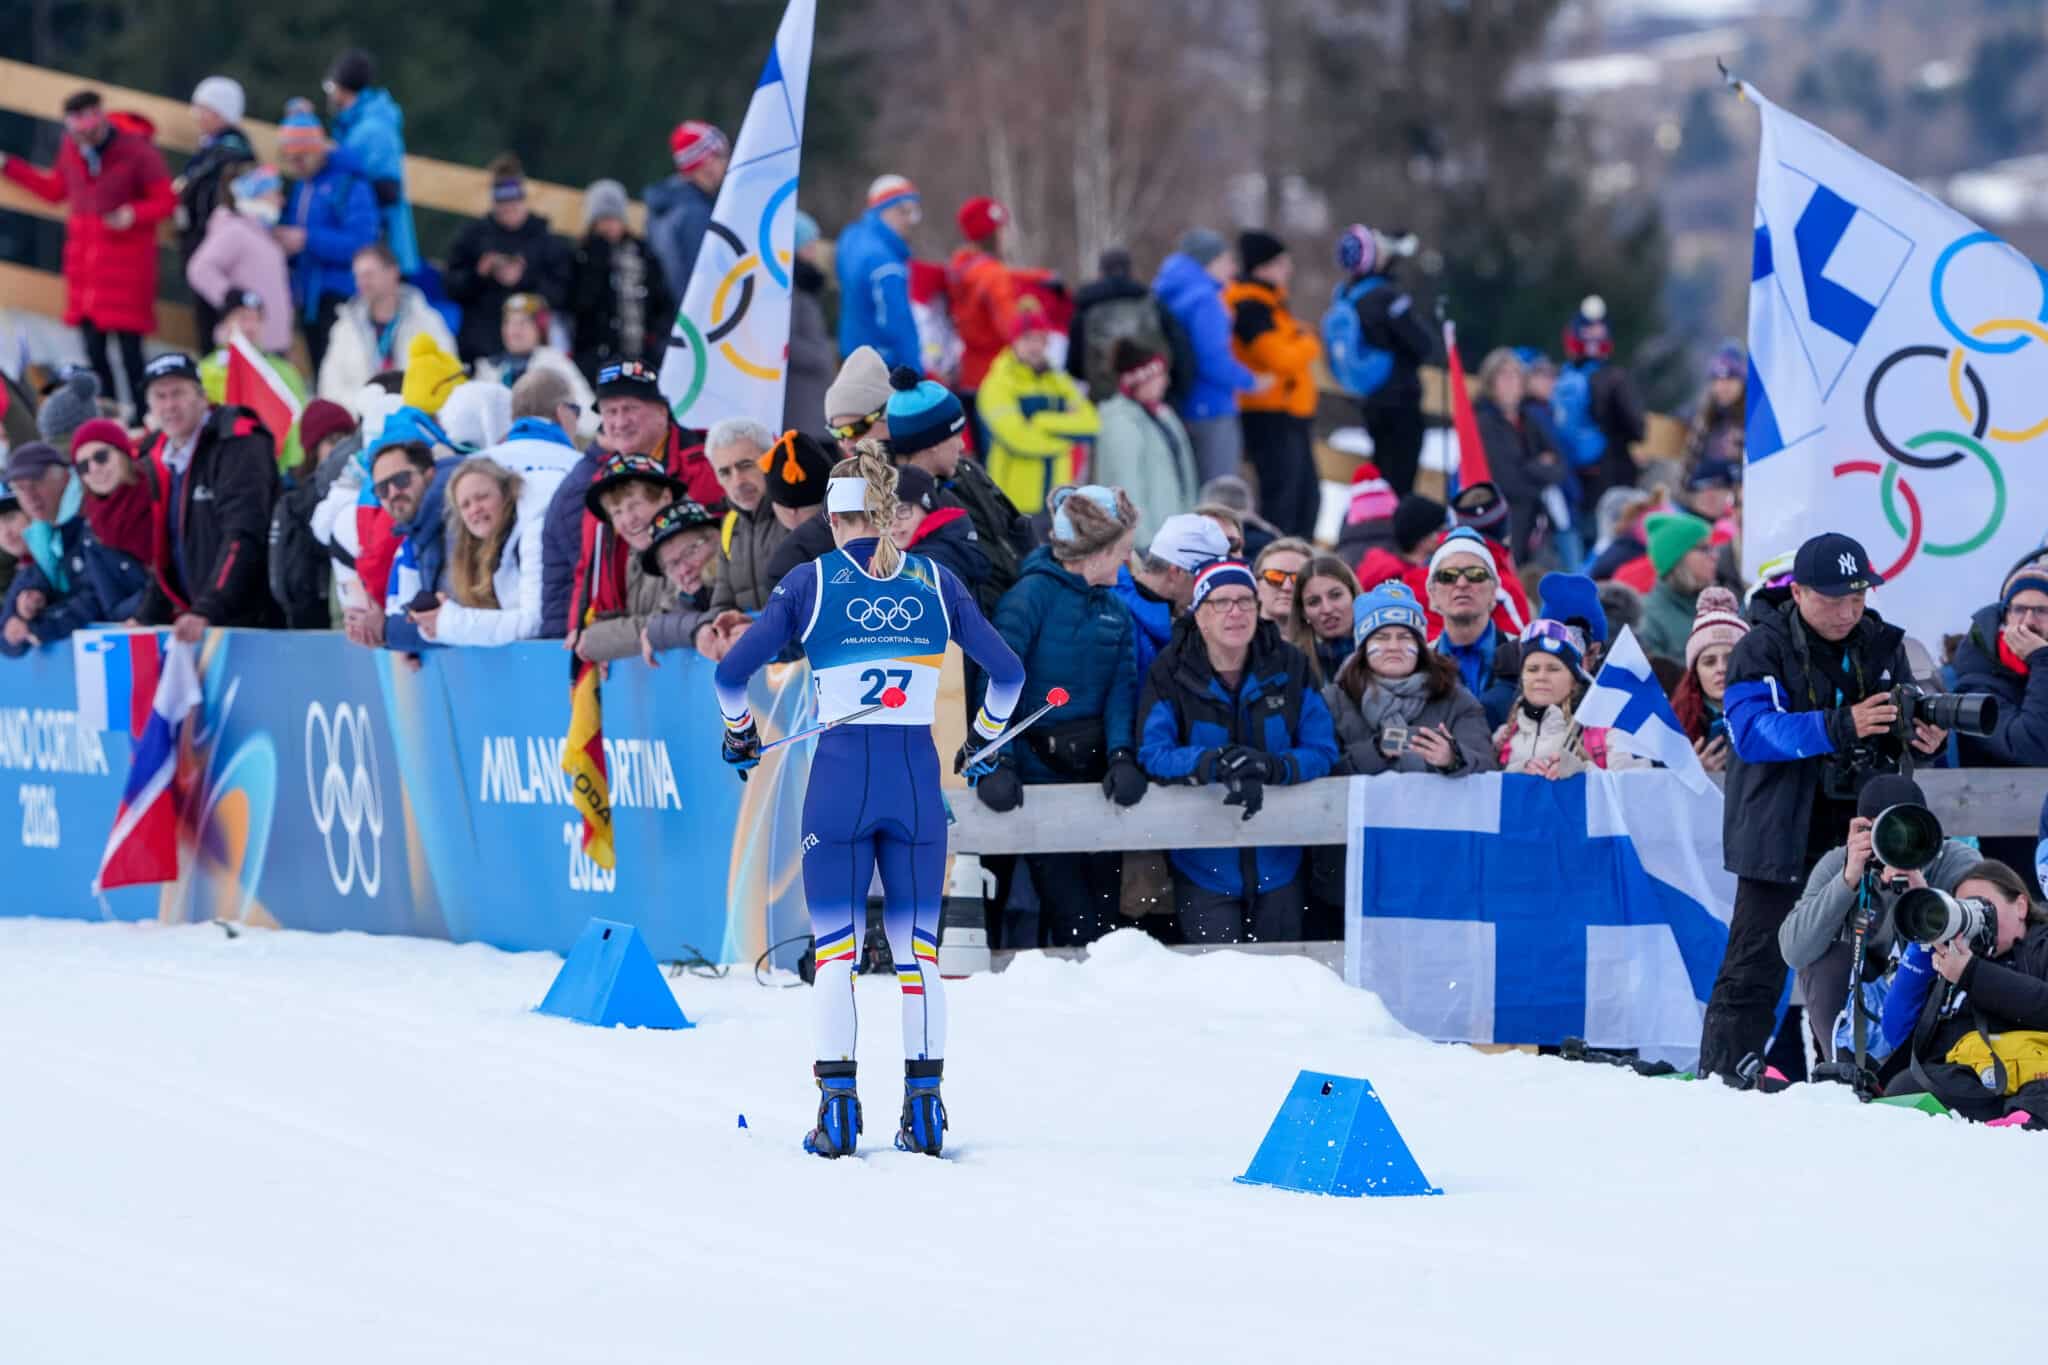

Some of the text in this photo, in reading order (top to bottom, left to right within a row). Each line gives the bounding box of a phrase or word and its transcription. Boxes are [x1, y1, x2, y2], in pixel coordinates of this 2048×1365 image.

[841, 636, 876, 645] MILANO
[878, 636, 912, 644] CORTINA
[860, 668, 913, 706] 27
[602, 737, 683, 810] ORTINA
